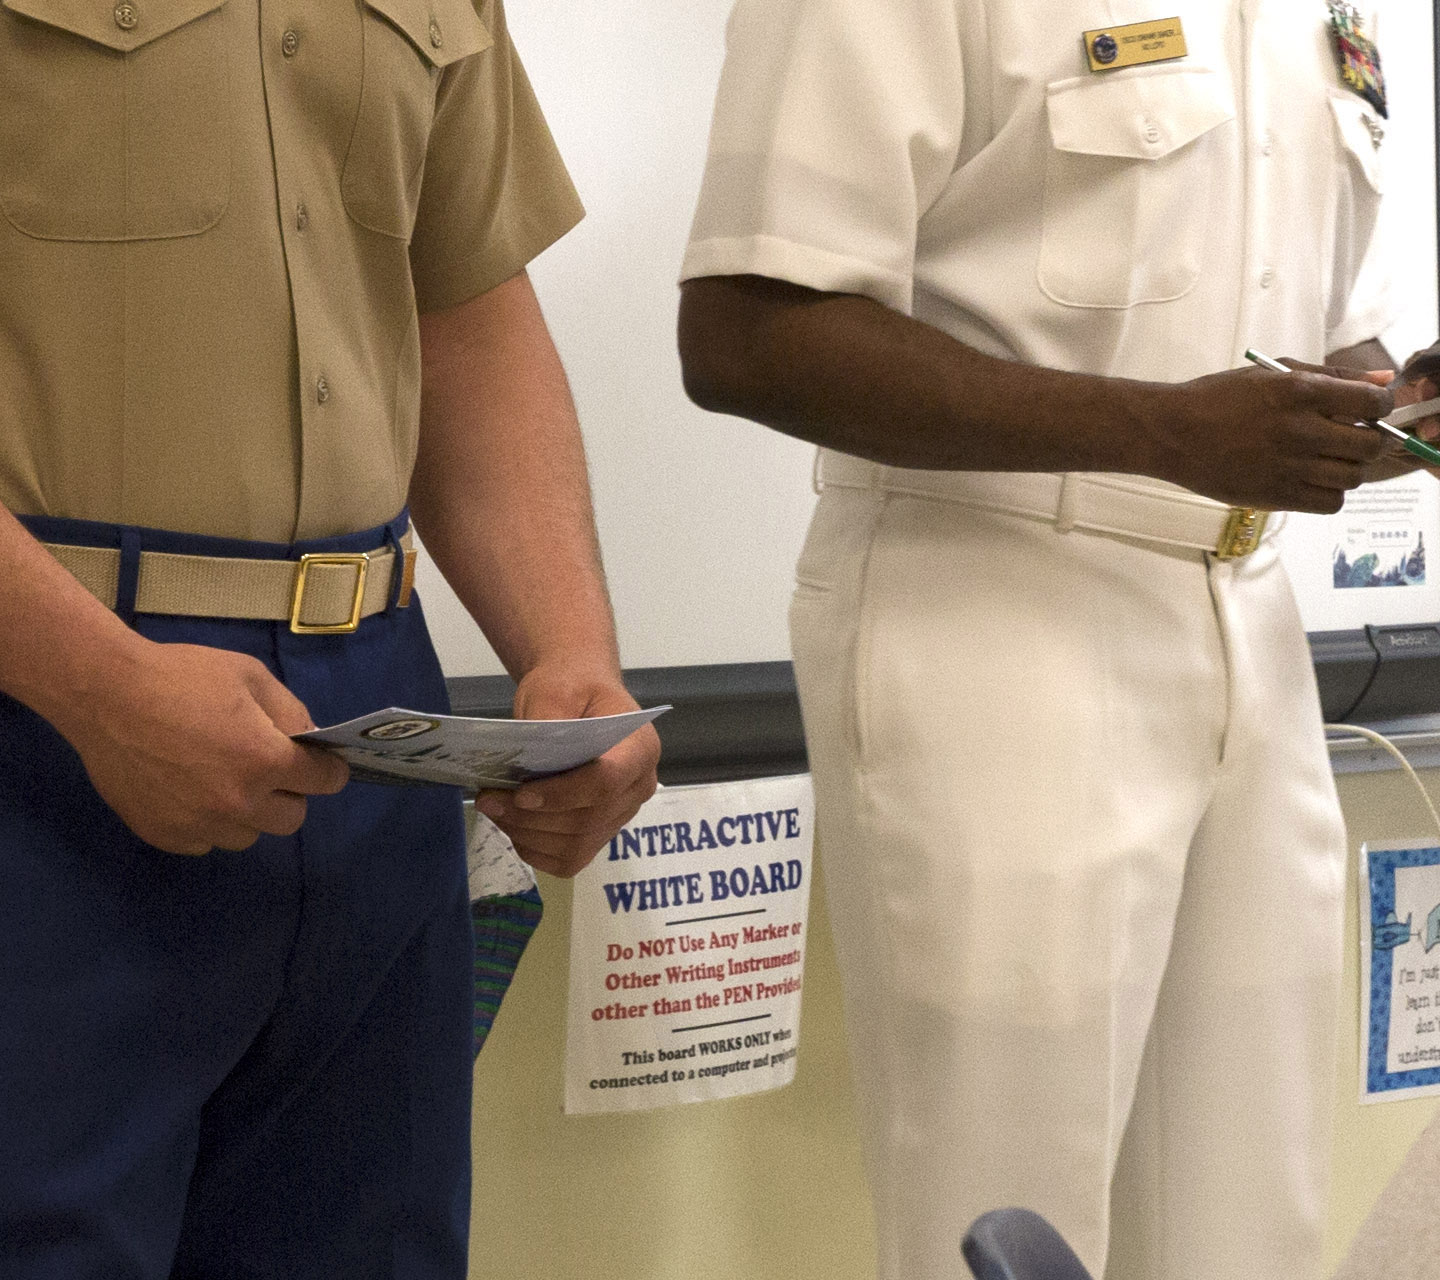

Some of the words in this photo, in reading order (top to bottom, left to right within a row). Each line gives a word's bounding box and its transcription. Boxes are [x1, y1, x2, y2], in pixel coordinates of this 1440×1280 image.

[608, 807, 801, 862] INTERACTIVE
[603, 872, 704, 914] WHITE
[709, 859, 802, 902] BOARD
[606, 943, 634, 962] Do
[638, 937, 676, 959] NOT
[678, 935, 705, 954] Use
[709, 931, 739, 951] Any
[742, 923, 790, 945] Marker
[791, 922, 802, 936] or
[605, 972, 661, 992] Other
[665, 963, 725, 985] Writing
[728, 949, 800, 976] Instruments
[591, 1002, 648, 1021] other
[653, 997, 692, 1016] than
[695, 991, 720, 1010] the
[723, 984, 753, 1007] PEN
[622, 1051, 654, 1066] This
[657, 1045, 696, 1062] board
[698, 1036, 742, 1057] WORKS
[744, 1031, 771, 1049] ONLY
[589, 1071, 668, 1090] connected
[671, 1071, 685, 1083] to
[687, 1071, 695, 1080] a
[698, 1061, 750, 1079] computer
[752, 1055, 768, 1070] and
